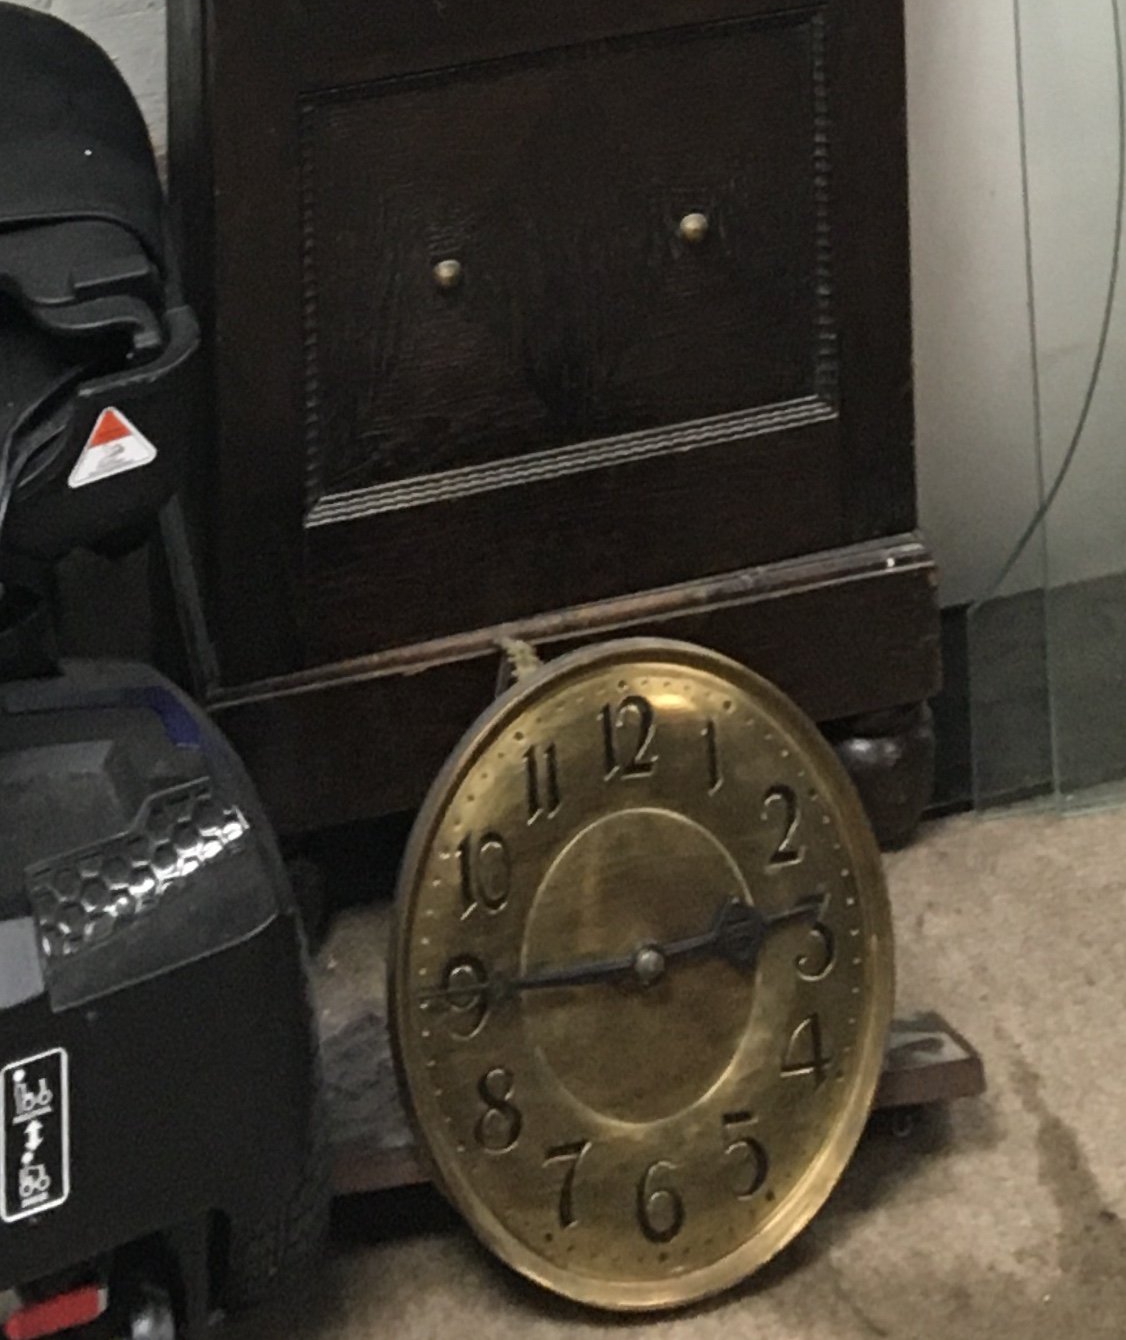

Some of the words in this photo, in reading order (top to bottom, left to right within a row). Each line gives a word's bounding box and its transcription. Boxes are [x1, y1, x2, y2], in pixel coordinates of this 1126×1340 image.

[599, 695, 659, 781] 12
[763, 784, 805, 869] 2
[456, 831, 511, 919] 10
[780, 1013, 832, 1087] 4
[474, 1068, 523, 1153] 8
[542, 1139, 591, 1229] 7
[721, 1111, 768, 1200] 5
[636, 1160, 684, 1244] 6
